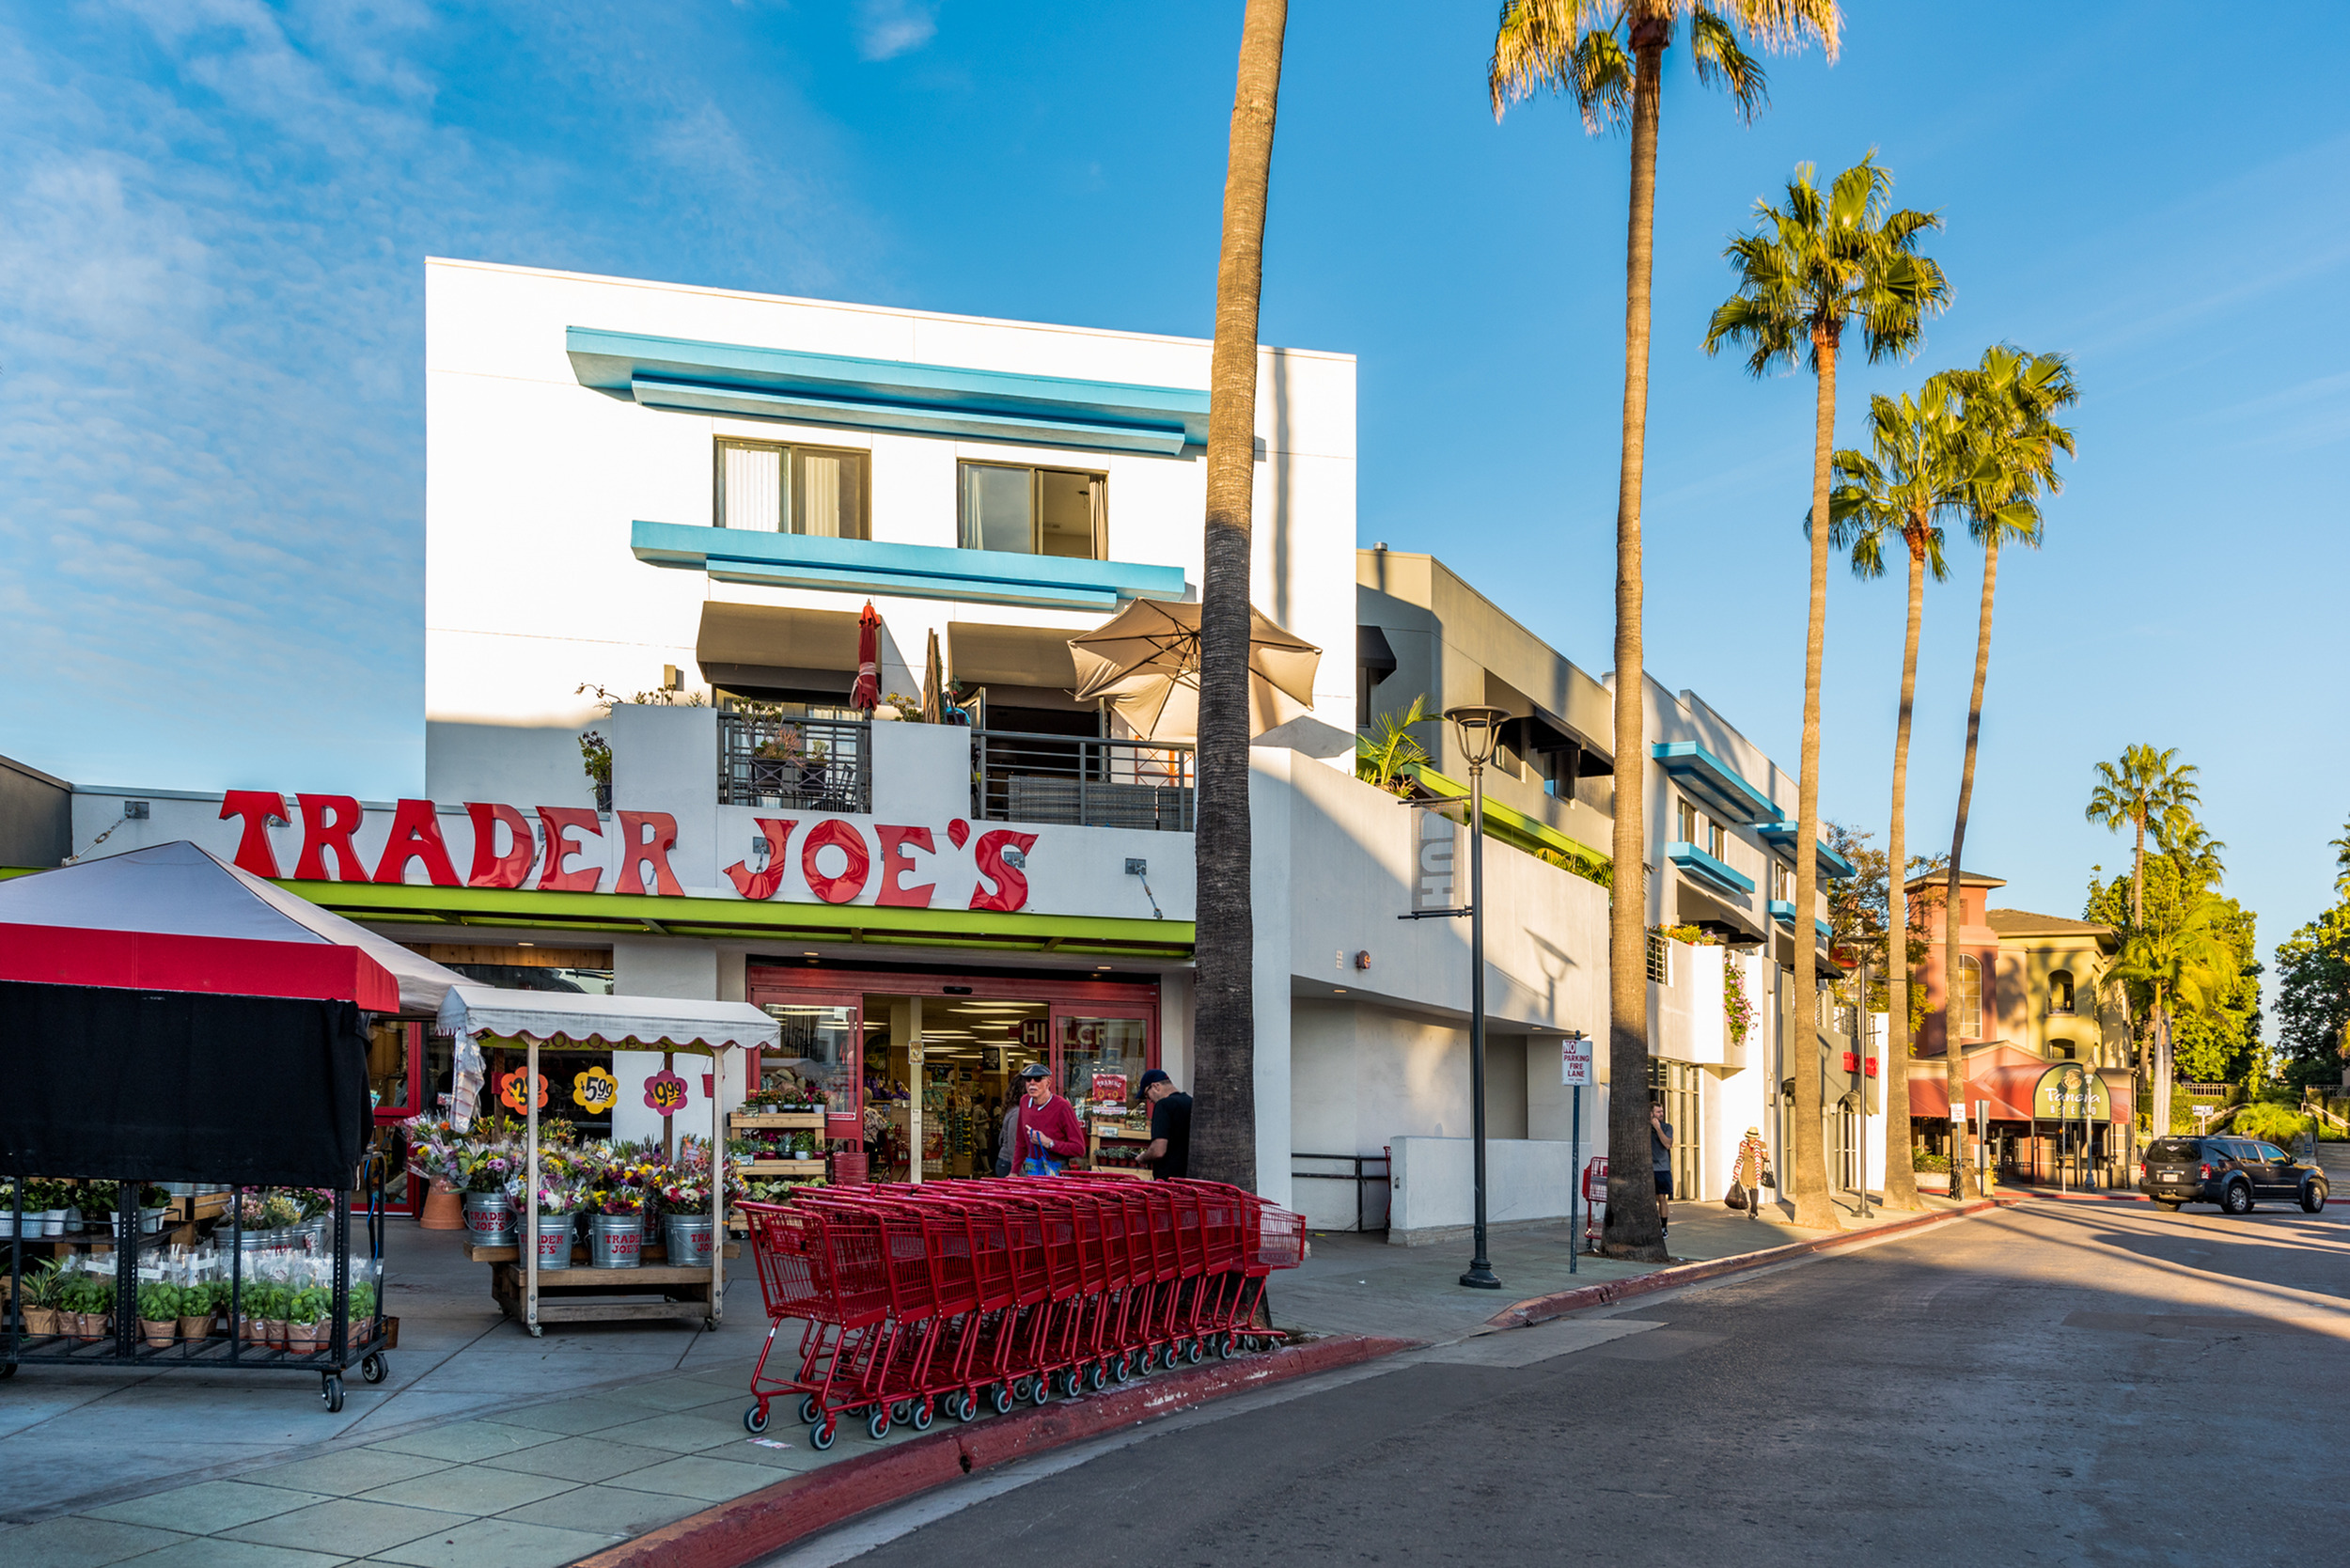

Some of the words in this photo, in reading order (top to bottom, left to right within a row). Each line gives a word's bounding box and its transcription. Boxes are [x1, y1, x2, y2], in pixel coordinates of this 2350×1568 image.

[218, 790, 685, 897] TRADER
[724, 818, 1040, 913] JOE'S
[1563, 1042, 1576, 1054] NO
[1563, 1055, 1590, 1063] PARKING
[469, 1211, 512, 1221] TRADER
[474, 1221, 507, 1231] JOE'S
[520, 1233, 564, 1244] TDER
[690, 1232, 712, 1243] TRA
[611, 1244, 640, 1254] JOE'S
